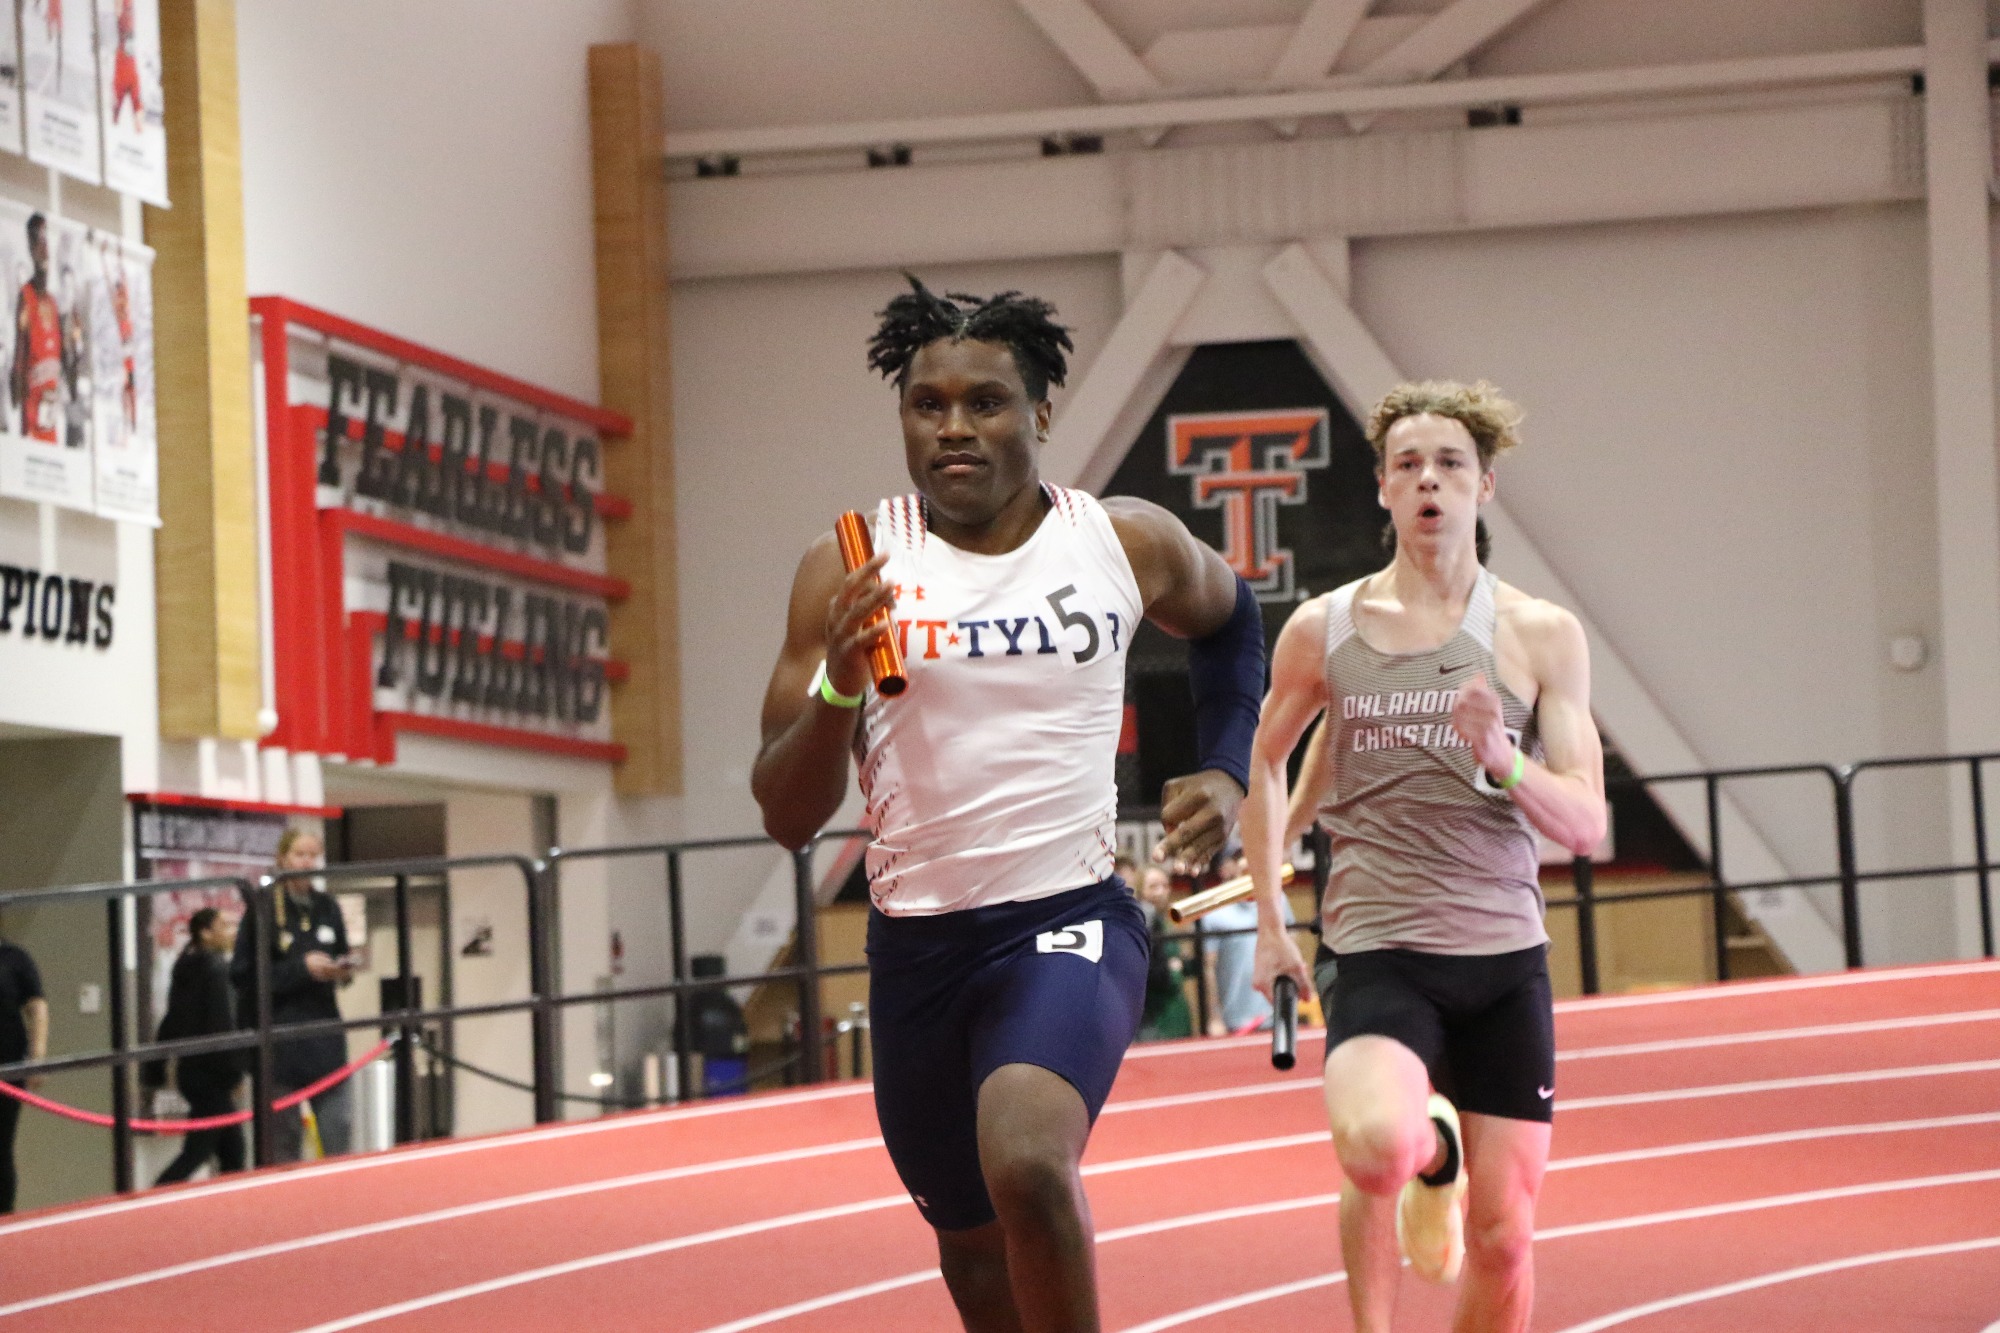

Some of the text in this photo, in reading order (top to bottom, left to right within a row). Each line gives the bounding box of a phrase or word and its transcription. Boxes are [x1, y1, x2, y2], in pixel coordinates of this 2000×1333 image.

[1045, 583, 1100, 664] 5
[1343, 690, 1459, 720] OKLAHOM
[1051, 922, 1087, 950] 5
